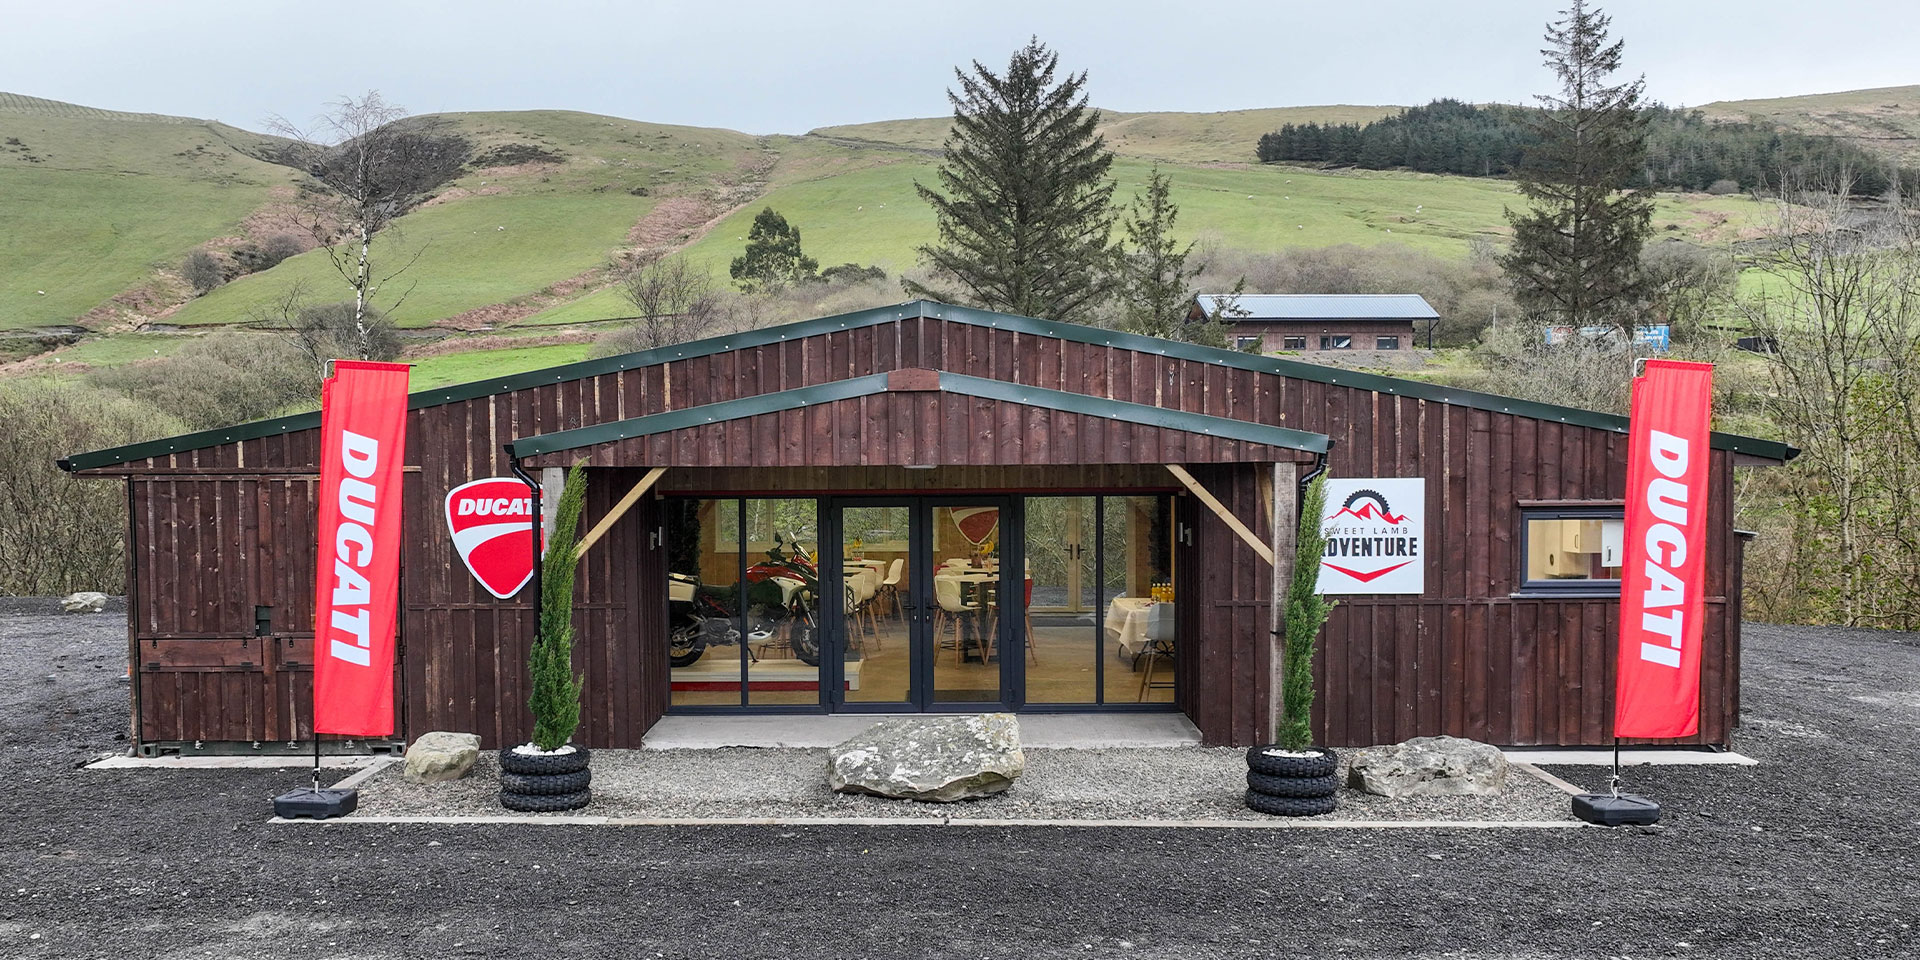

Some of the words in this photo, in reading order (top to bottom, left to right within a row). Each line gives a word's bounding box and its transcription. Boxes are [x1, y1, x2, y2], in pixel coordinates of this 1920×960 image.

[457, 498, 544, 516] DUCAT
[1324, 527, 1365, 535] SWEET
[1373, 526, 1408, 535] LAMB
[330, 429, 379, 667] DUCATI
[1320, 537, 1418, 557] DVENTURE
[1640, 429, 1689, 669] DUCATI
